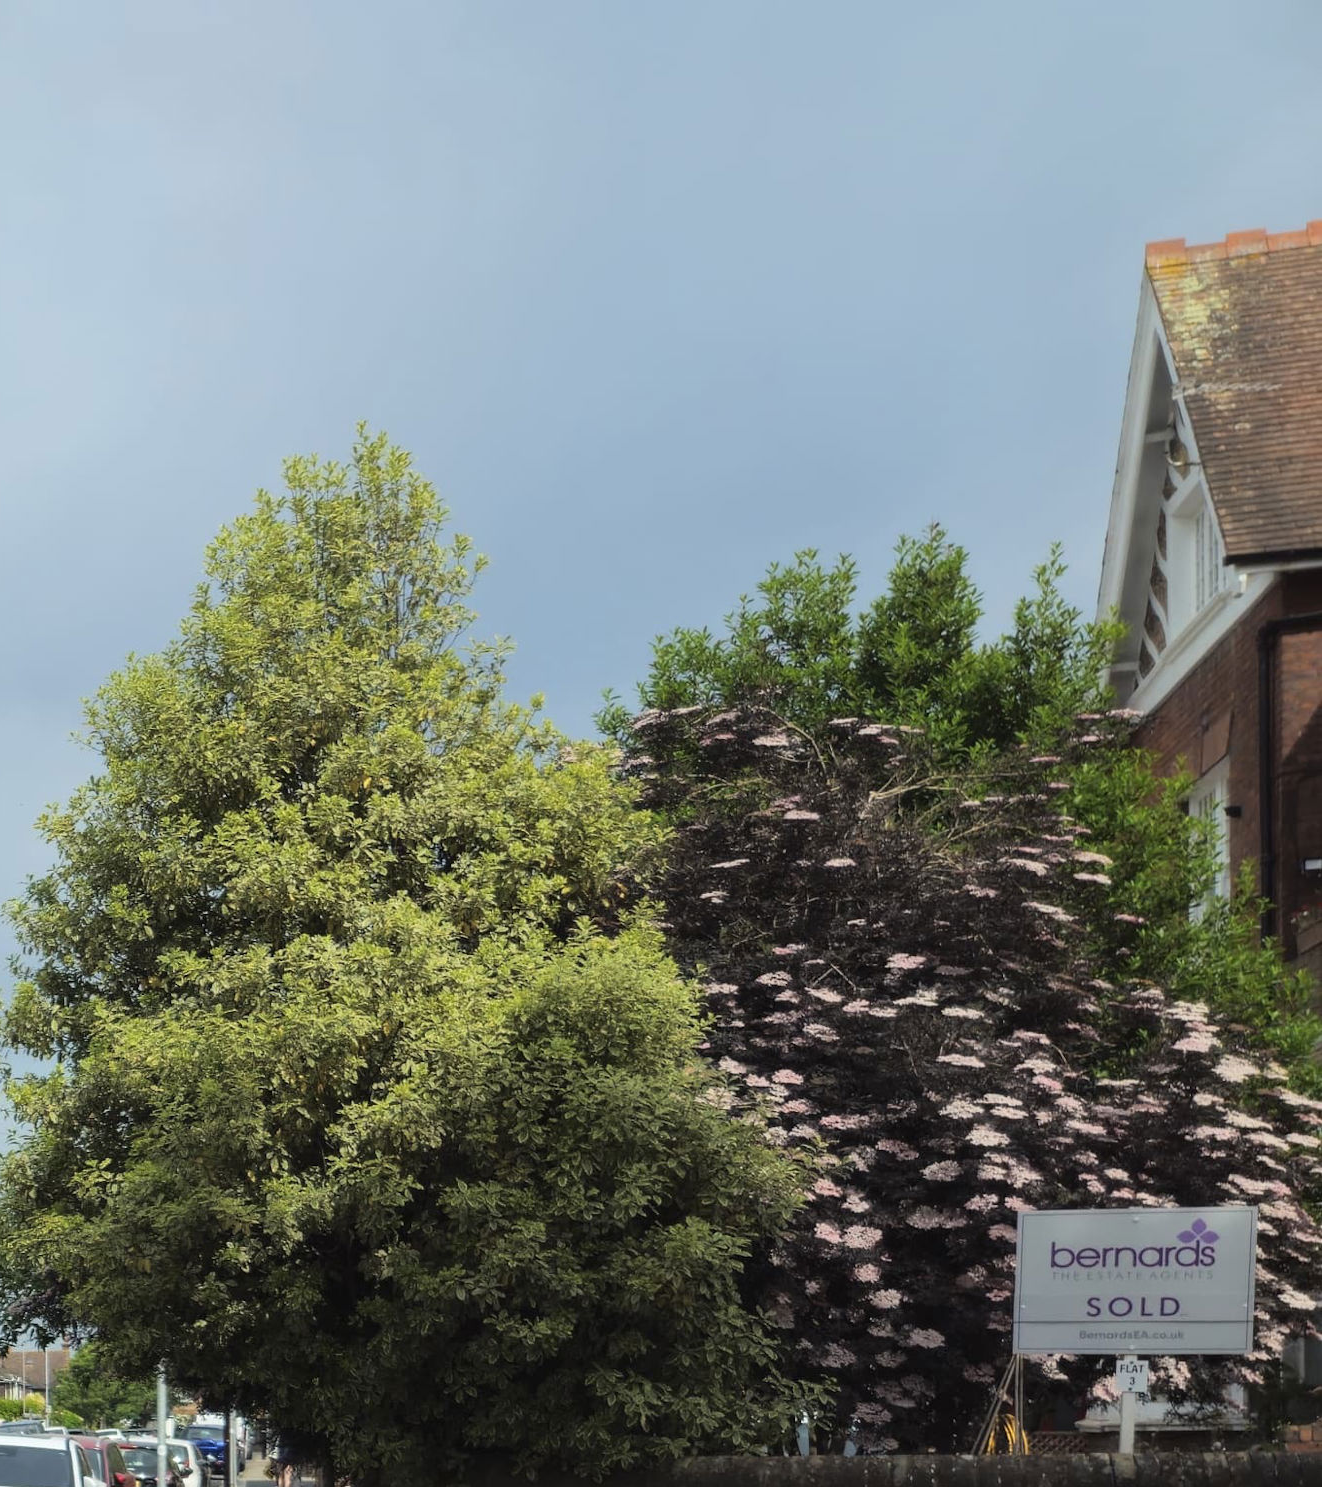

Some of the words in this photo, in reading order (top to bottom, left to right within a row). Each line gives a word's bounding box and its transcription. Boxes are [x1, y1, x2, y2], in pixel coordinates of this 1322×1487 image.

[1050, 1240, 1216, 1268] bernards
[1053, 1271, 1079, 1281] THE
[1086, 1271, 1142, 1281] ESTATE
[1149, 1270, 1214, 1281] AGENTS
[1086, 1296, 1180, 1317] SOLD
[1079, 1329, 1185, 1340] BernardsEA.co.uk
[1119, 1364, 1144, 1373] FLAT
[1129, 1377, 1136, 1385] 3
